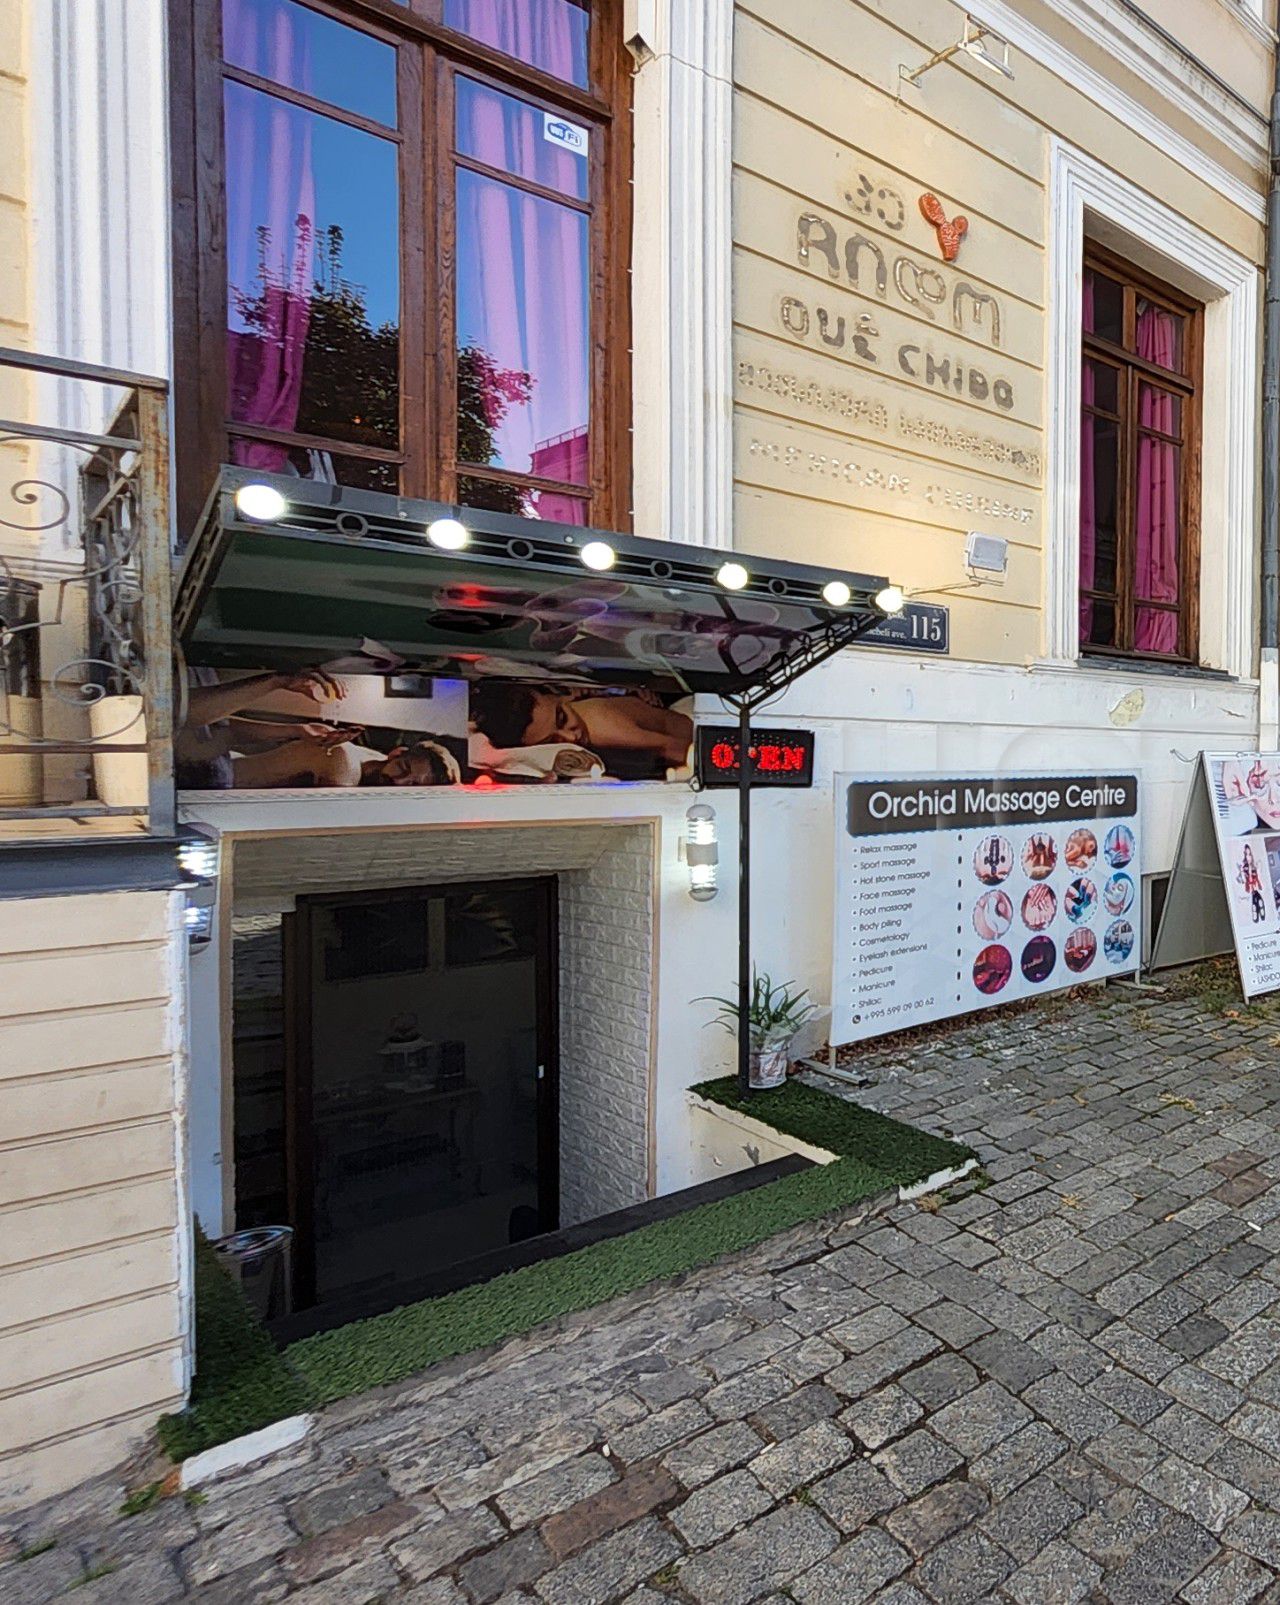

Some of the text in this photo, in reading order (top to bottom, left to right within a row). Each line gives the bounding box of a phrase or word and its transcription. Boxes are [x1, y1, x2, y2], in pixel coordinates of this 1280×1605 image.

[911, 614, 942, 641] 115
[868, 784, 1126, 819] Orchid Massage Centre
[860, 843, 918, 854] Relax massage
[860, 858, 916, 870] Sport massage
[860, 871, 931, 885] Hot stone massage
[859, 887, 916, 901] Face massage
[859, 902, 913, 916] Foot massage
[859, 922, 879, 932] Body
[859, 932, 910, 947] Cosmetology
[1251, 940, 1277, 951] Pedicure
[859, 943, 928, 963] Eyelash extensions
[1253, 950, 1280, 961] Manicure
[858, 965, 893, 978] Pedicure
[858, 979, 896, 993] Manicure
[864, 996, 935, 1020] +995 599 09 00 62
